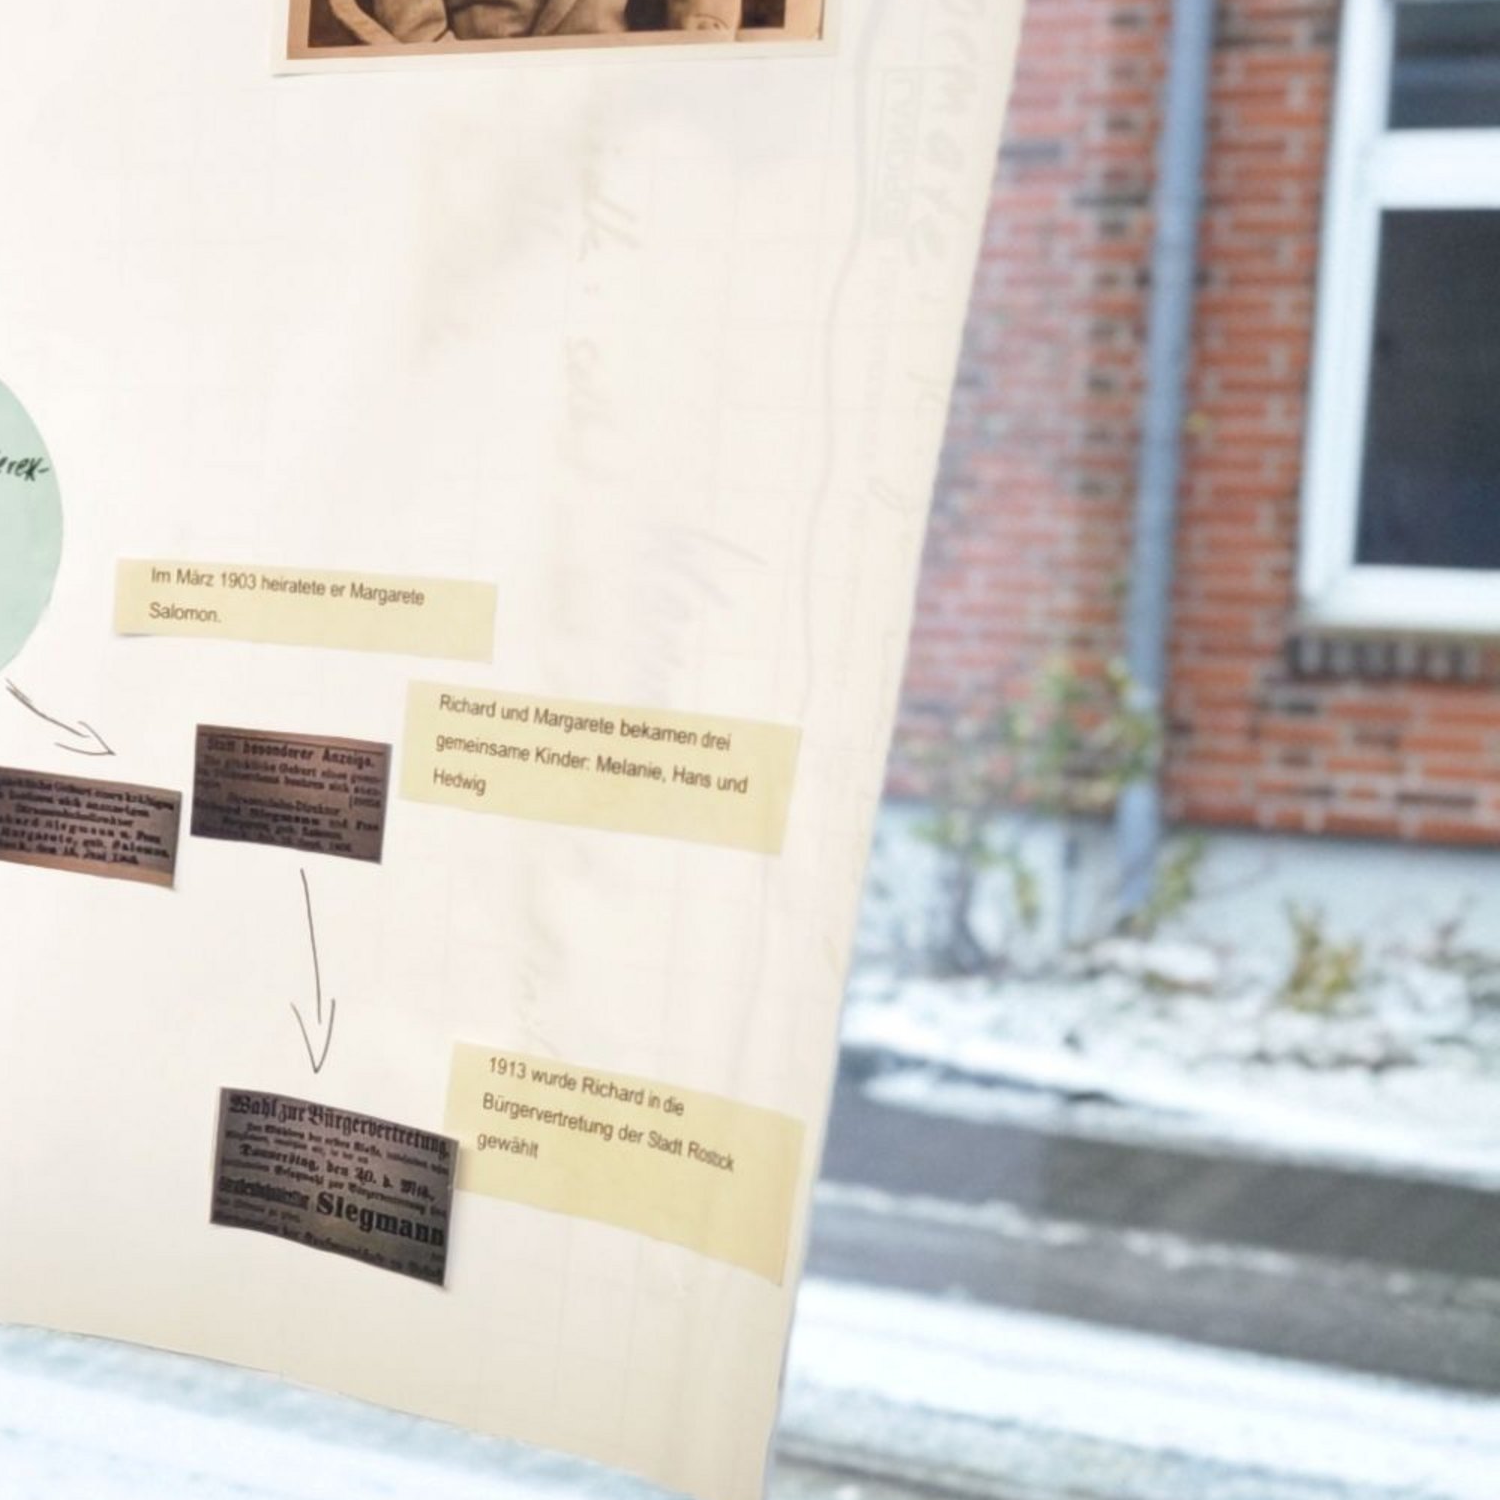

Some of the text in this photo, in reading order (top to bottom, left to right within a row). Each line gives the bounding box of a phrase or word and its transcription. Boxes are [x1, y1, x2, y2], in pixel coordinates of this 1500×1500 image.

[148, 601, 222, 623] Salomon.
[176, 568, 215, 587] März
[221, 572, 256, 591] 1903
[260, 575, 326, 597] heiratete
[330, 583, 346, 597] er
[350, 582, 425, 607] Margarete
[439, 693, 732, 752] Richard und Margarete bekamen drei
[433, 768, 487, 796] Hedwig
[435, 734, 748, 795] gemeinsame Kinder: Melanie, Hans und
[489, 1056, 685, 1116] 1913 wurde Richard in die
[477, 1132, 539, 1159] gewählt
[482, 1092, 614, 1142] Bürgervertretung
[618, 1124, 644, 1144] der
[648, 1131, 683, 1155] Stadt
